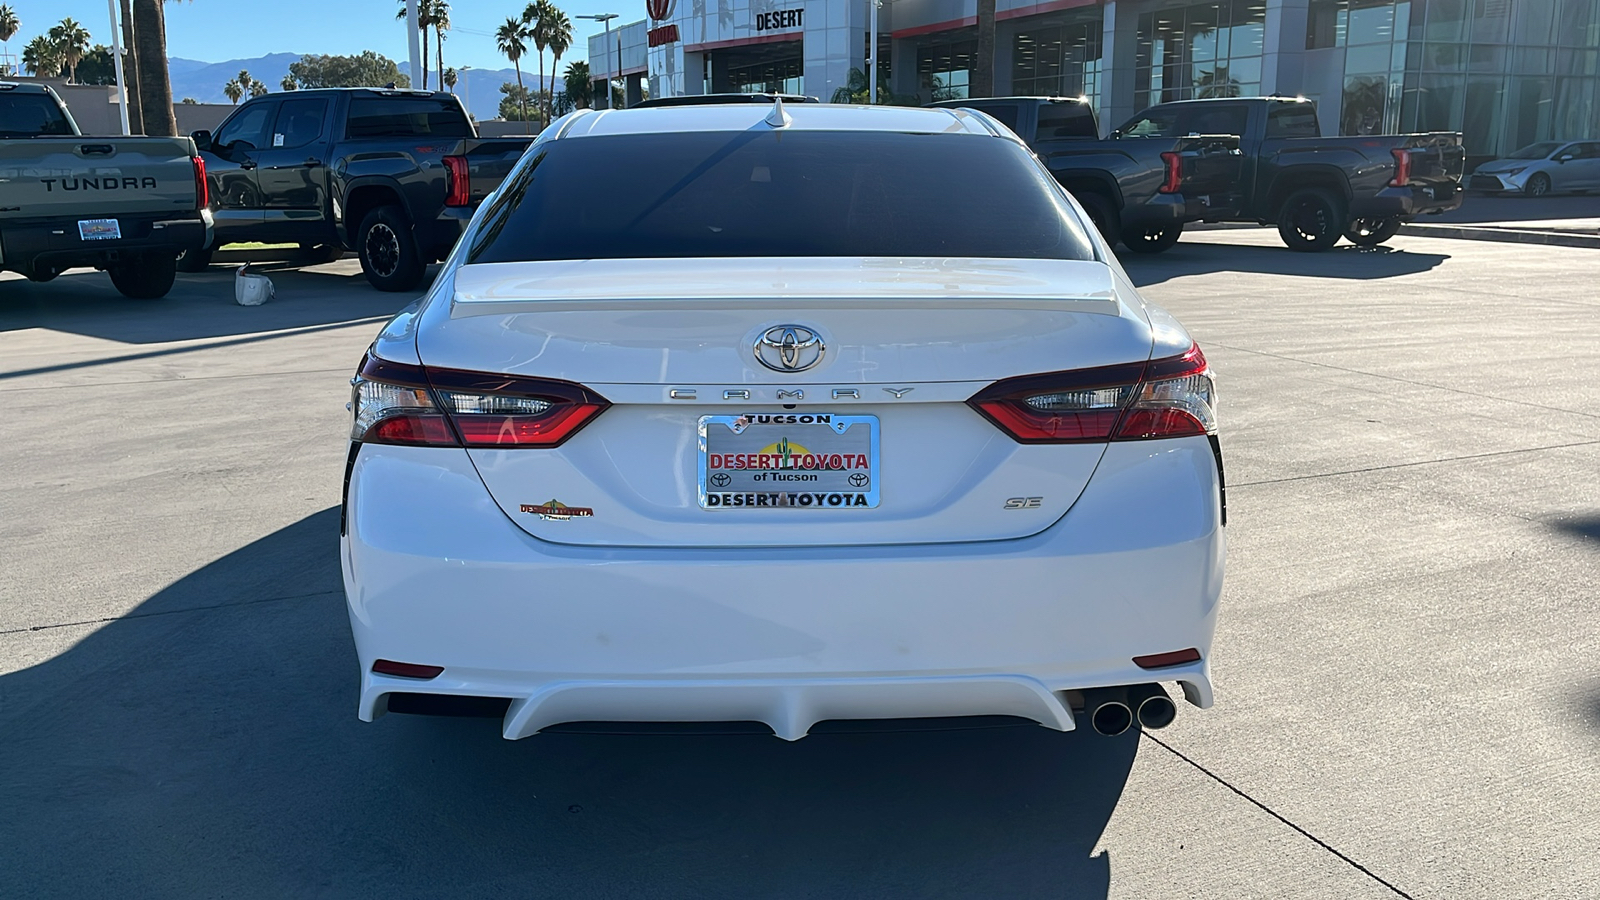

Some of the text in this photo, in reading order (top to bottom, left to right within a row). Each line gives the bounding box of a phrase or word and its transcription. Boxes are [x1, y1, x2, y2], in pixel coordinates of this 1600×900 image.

[756, 8, 804, 31] DESERT
[40, 177, 157, 192] TUNDRA
[670, 388, 915, 399] CAMRY
[745, 415, 831, 424] TUCSON
[710, 453, 869, 469] DESERT TOYOTA
[753, 472, 818, 482] of Tucson
[708, 494, 868, 507] DESERT TOYOTA
[1003, 496, 1044, 509] SE
